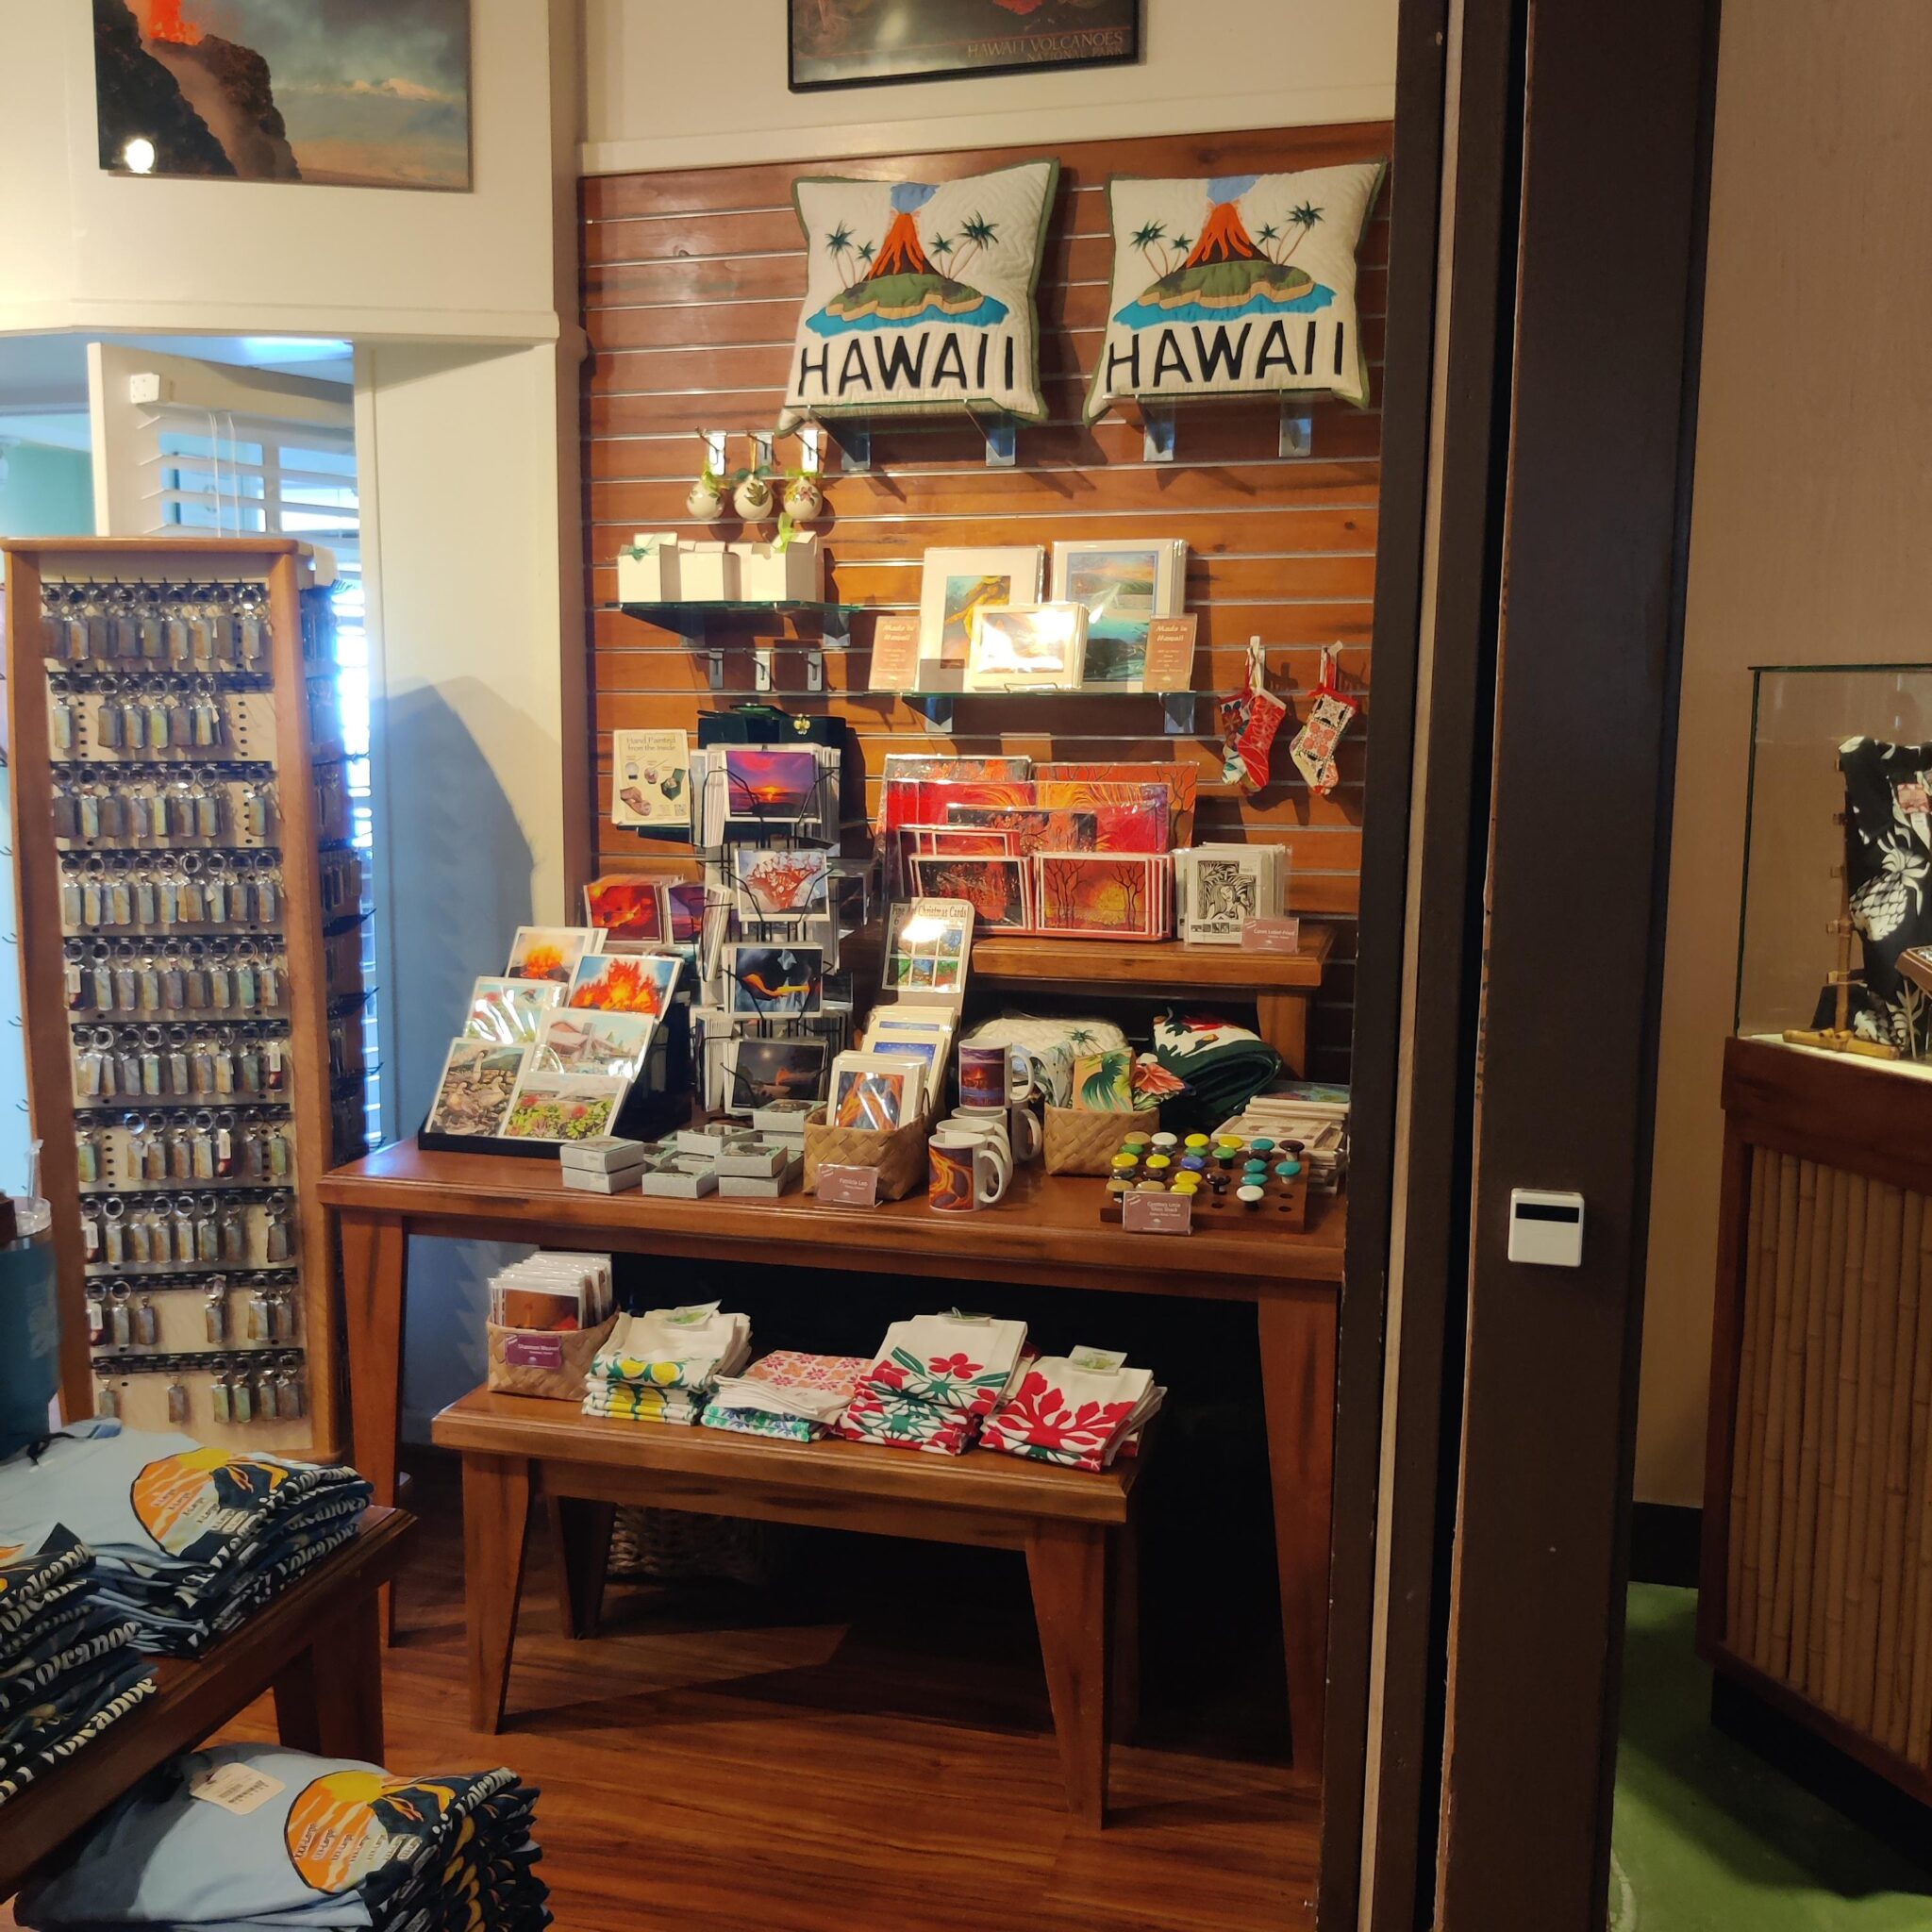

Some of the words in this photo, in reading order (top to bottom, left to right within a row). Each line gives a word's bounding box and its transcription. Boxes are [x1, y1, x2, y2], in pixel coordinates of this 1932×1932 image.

[1030, 31, 1123, 52] VOLCANOES
[1027, 48, 1085, 62] NATIONAL
[798, 332, 1013, 396] HAWAII
[1107, 320, 1343, 392] HAWAII
[919, 906, 948, 918] Christmas
[950, 907, 967, 918] Cards
